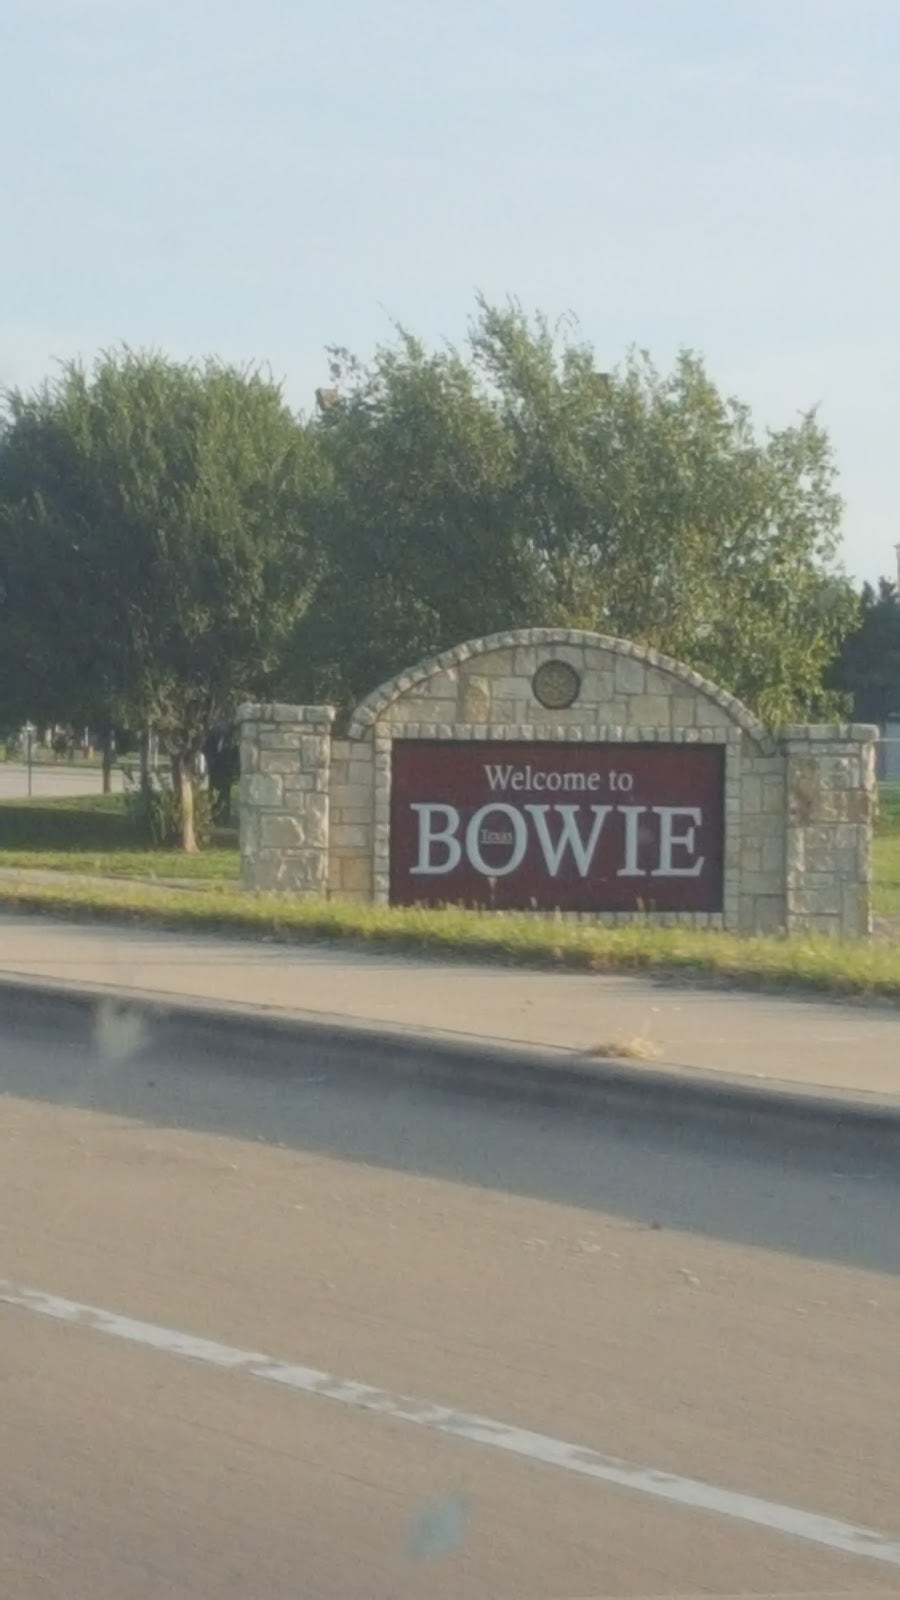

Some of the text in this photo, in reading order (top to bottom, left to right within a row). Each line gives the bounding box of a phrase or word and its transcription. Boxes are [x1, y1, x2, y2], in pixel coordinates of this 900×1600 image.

[484, 765, 634, 791] Welcome to
[409, 803, 705, 877] BOWIE
